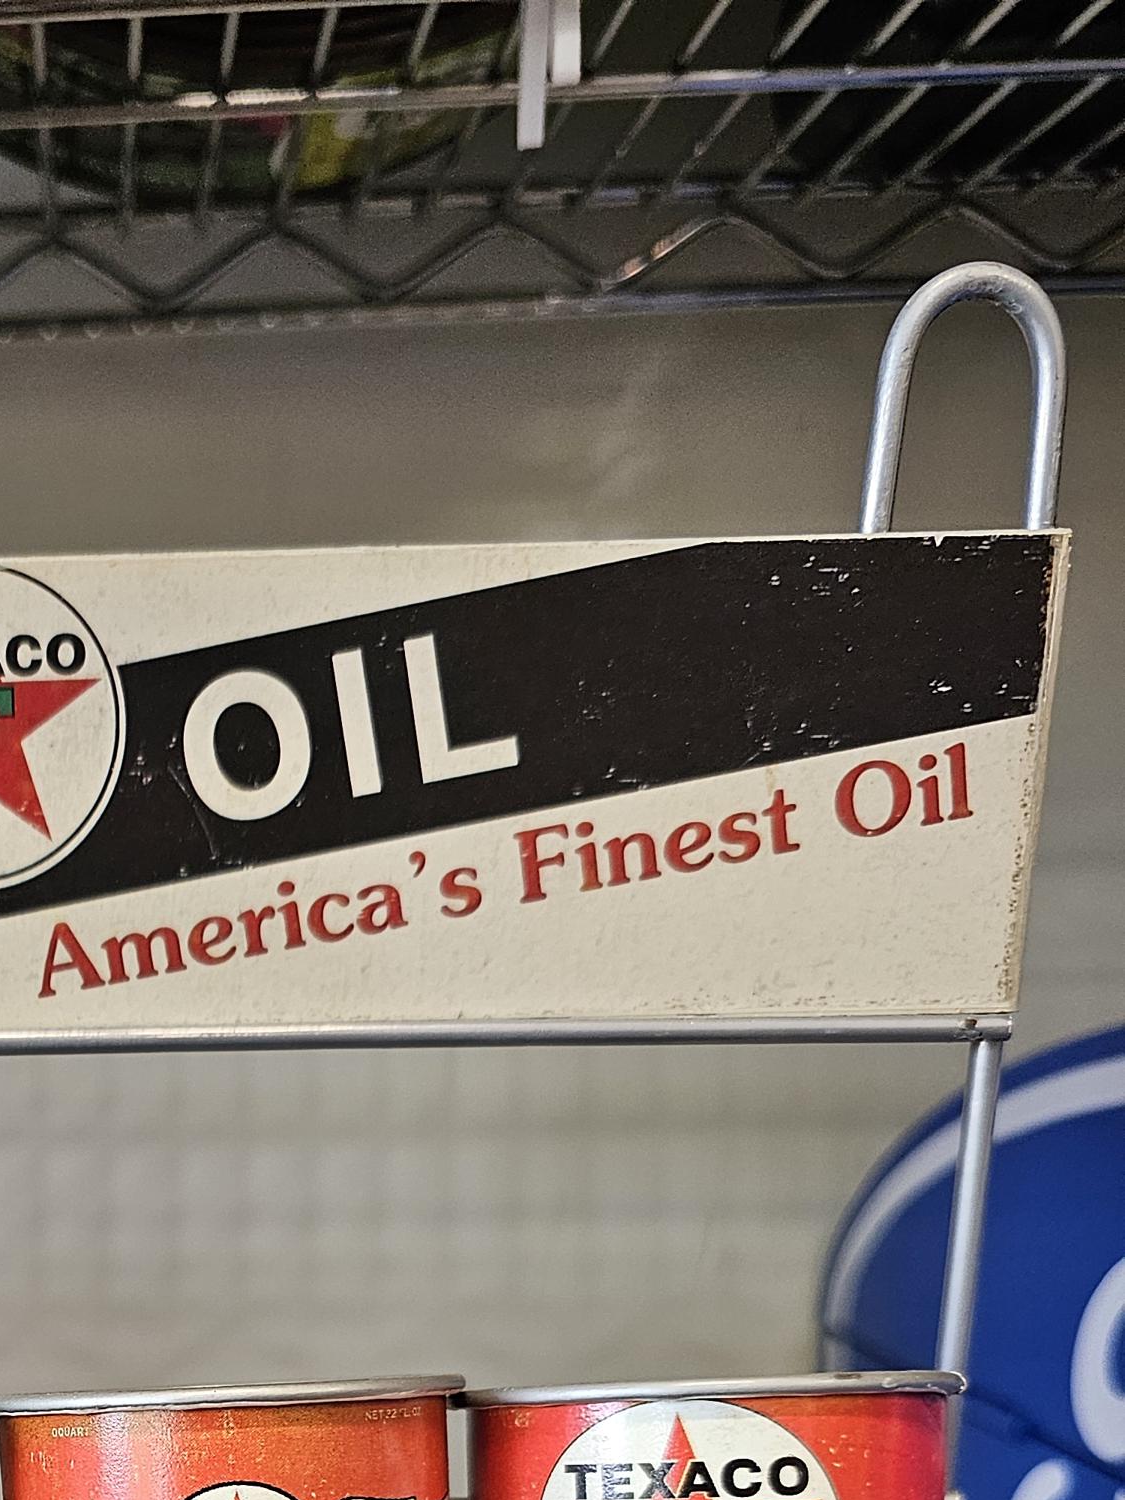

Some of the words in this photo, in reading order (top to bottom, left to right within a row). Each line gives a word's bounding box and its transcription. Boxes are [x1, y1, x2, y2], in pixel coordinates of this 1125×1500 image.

[182, 634, 521, 821] OIL
[38, 851, 483, 997] America's
[518, 789, 800, 904] Finest
[835, 742, 974, 838] Oil
[564, 1456, 810, 1500] TEXACO
